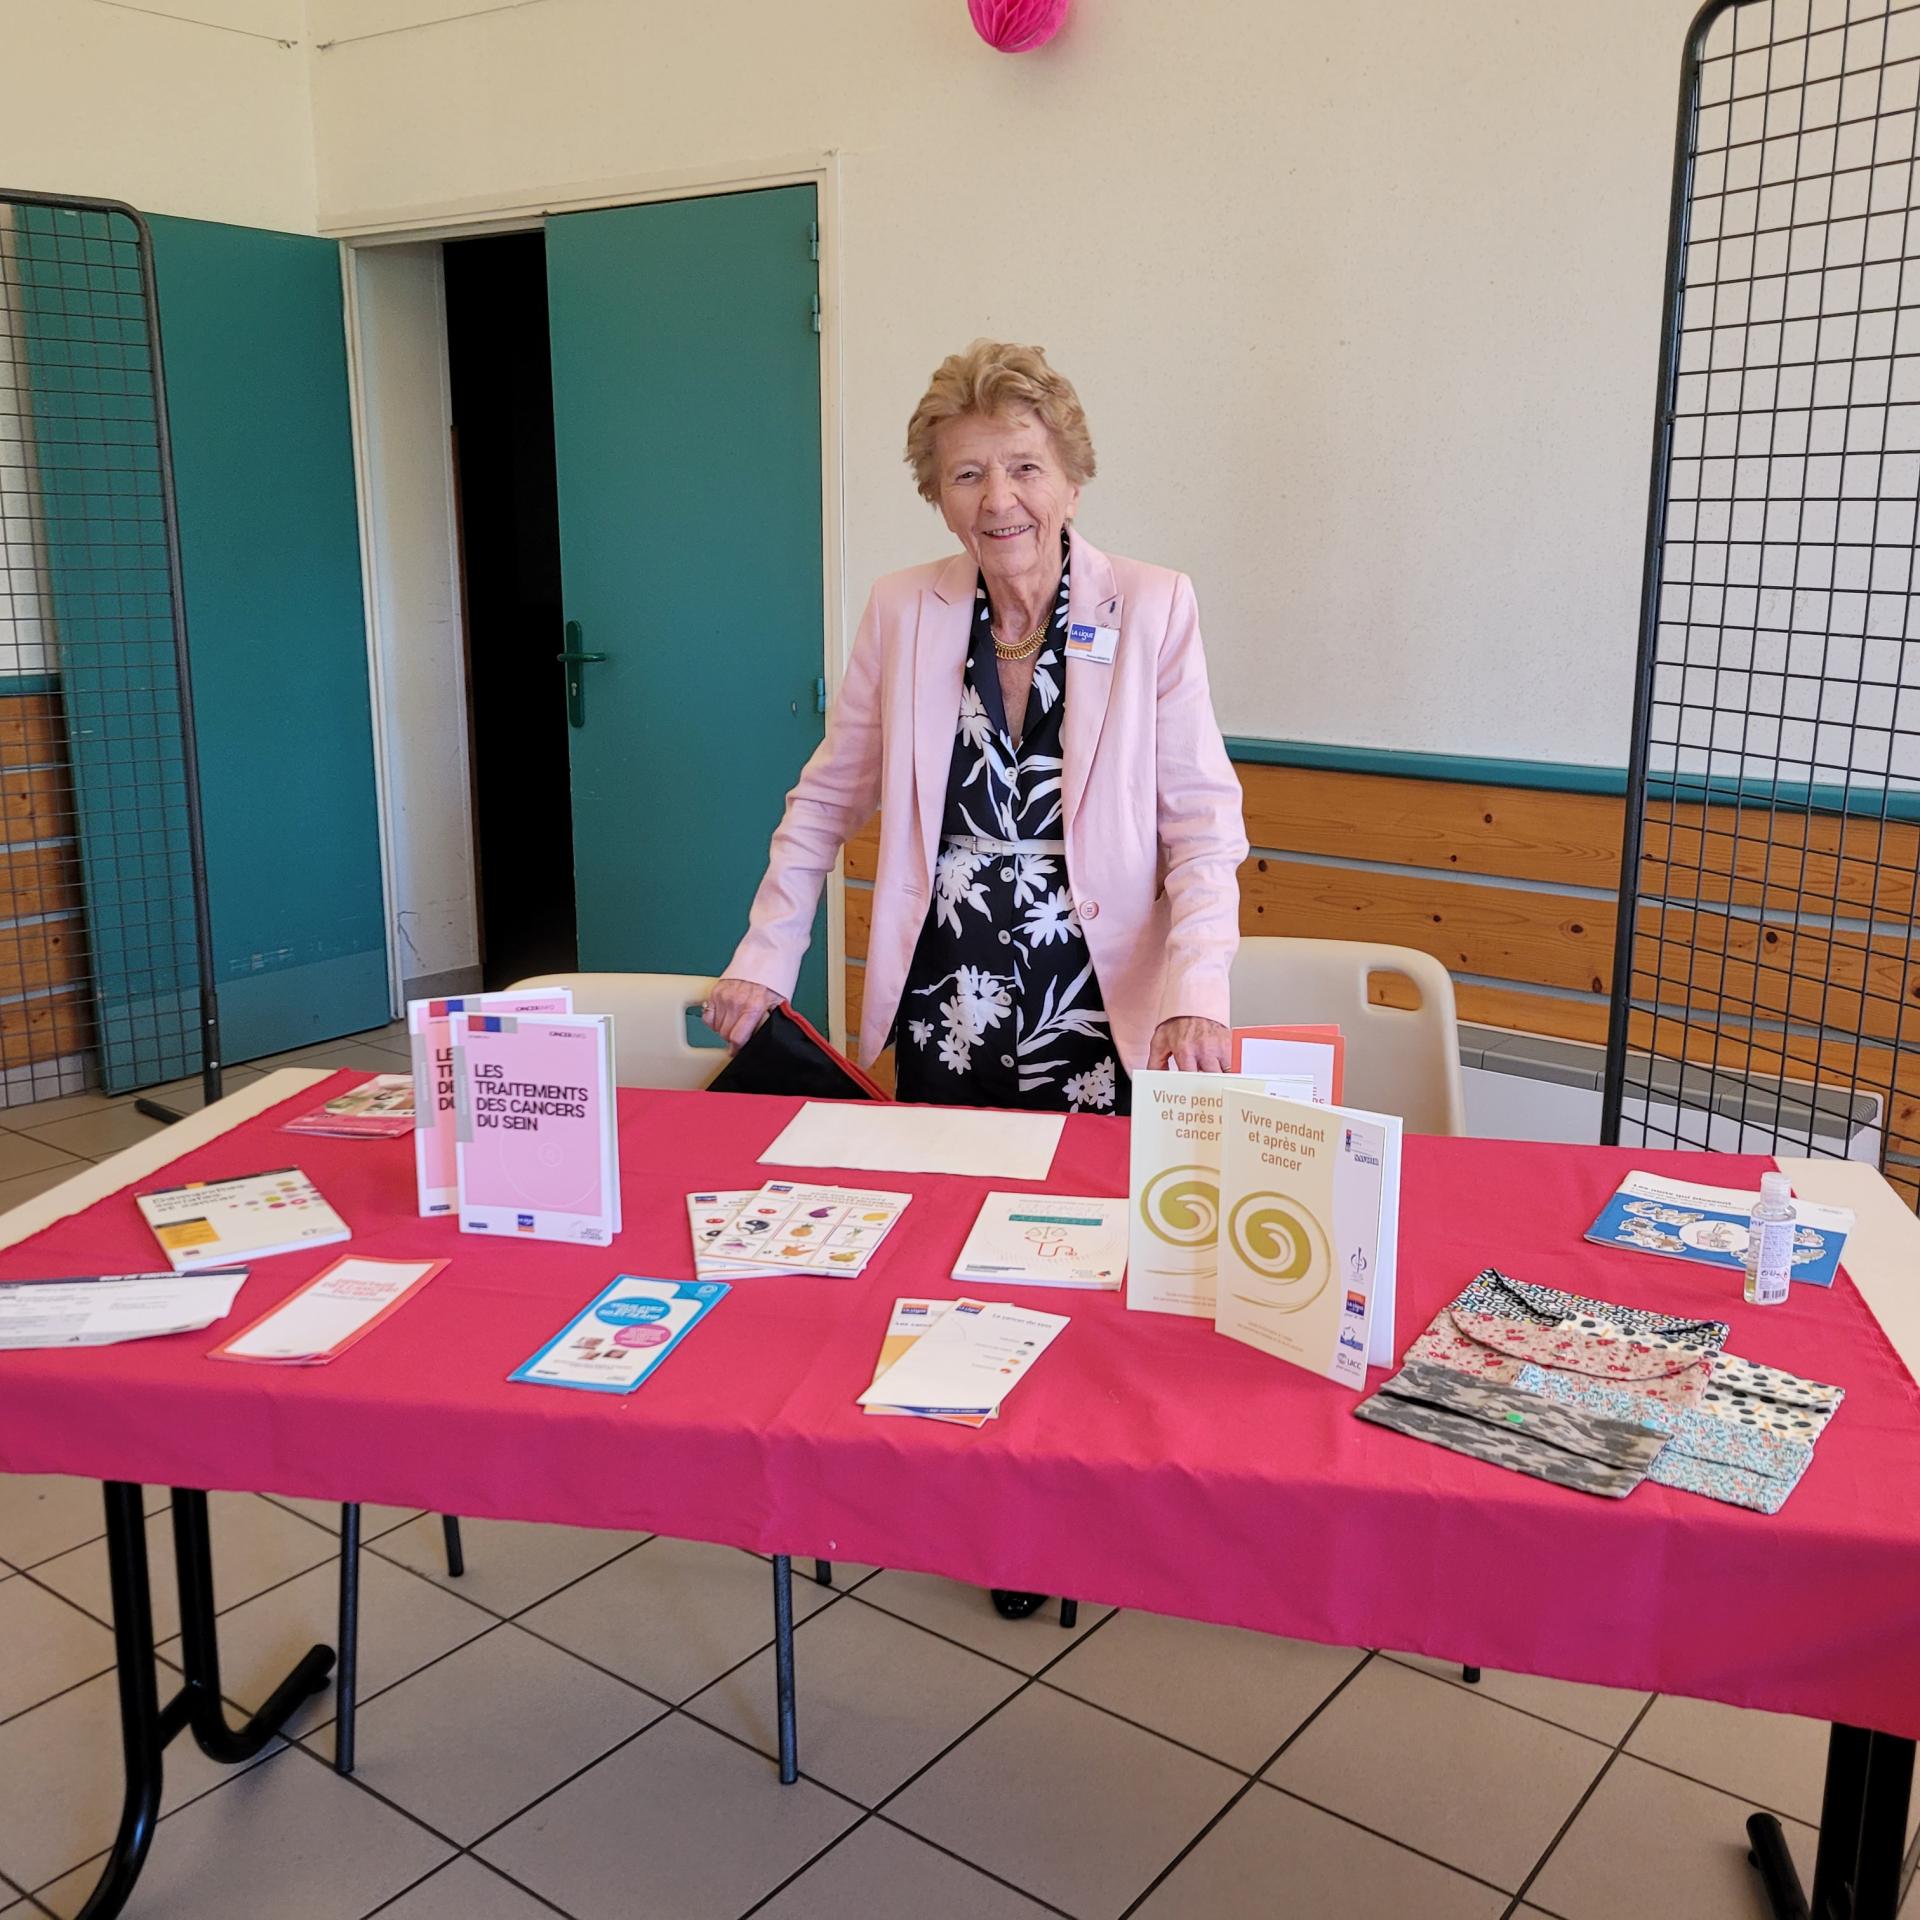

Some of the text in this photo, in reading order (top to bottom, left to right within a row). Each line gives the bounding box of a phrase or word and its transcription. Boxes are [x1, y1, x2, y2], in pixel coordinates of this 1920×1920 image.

[436, 1047, 453, 1062] LE
[475, 1064, 503, 1079] LES
[475, 1080, 589, 1102] TRAITEMENTS
[1153, 1089, 1223, 1108] Vivre pend
[476, 1097, 586, 1119] DES CANCERS
[1161, 1109, 1173, 1121] et
[1177, 1110, 1214, 1126] après
[477, 1113, 539, 1131] DU SEIN
[1241, 1108, 1325, 1143] Vivre pendant
[1175, 1128, 1221, 1142] cancer
[1249, 1130, 1315, 1158] et après un
[1261, 1151, 1302, 1172] cancer
